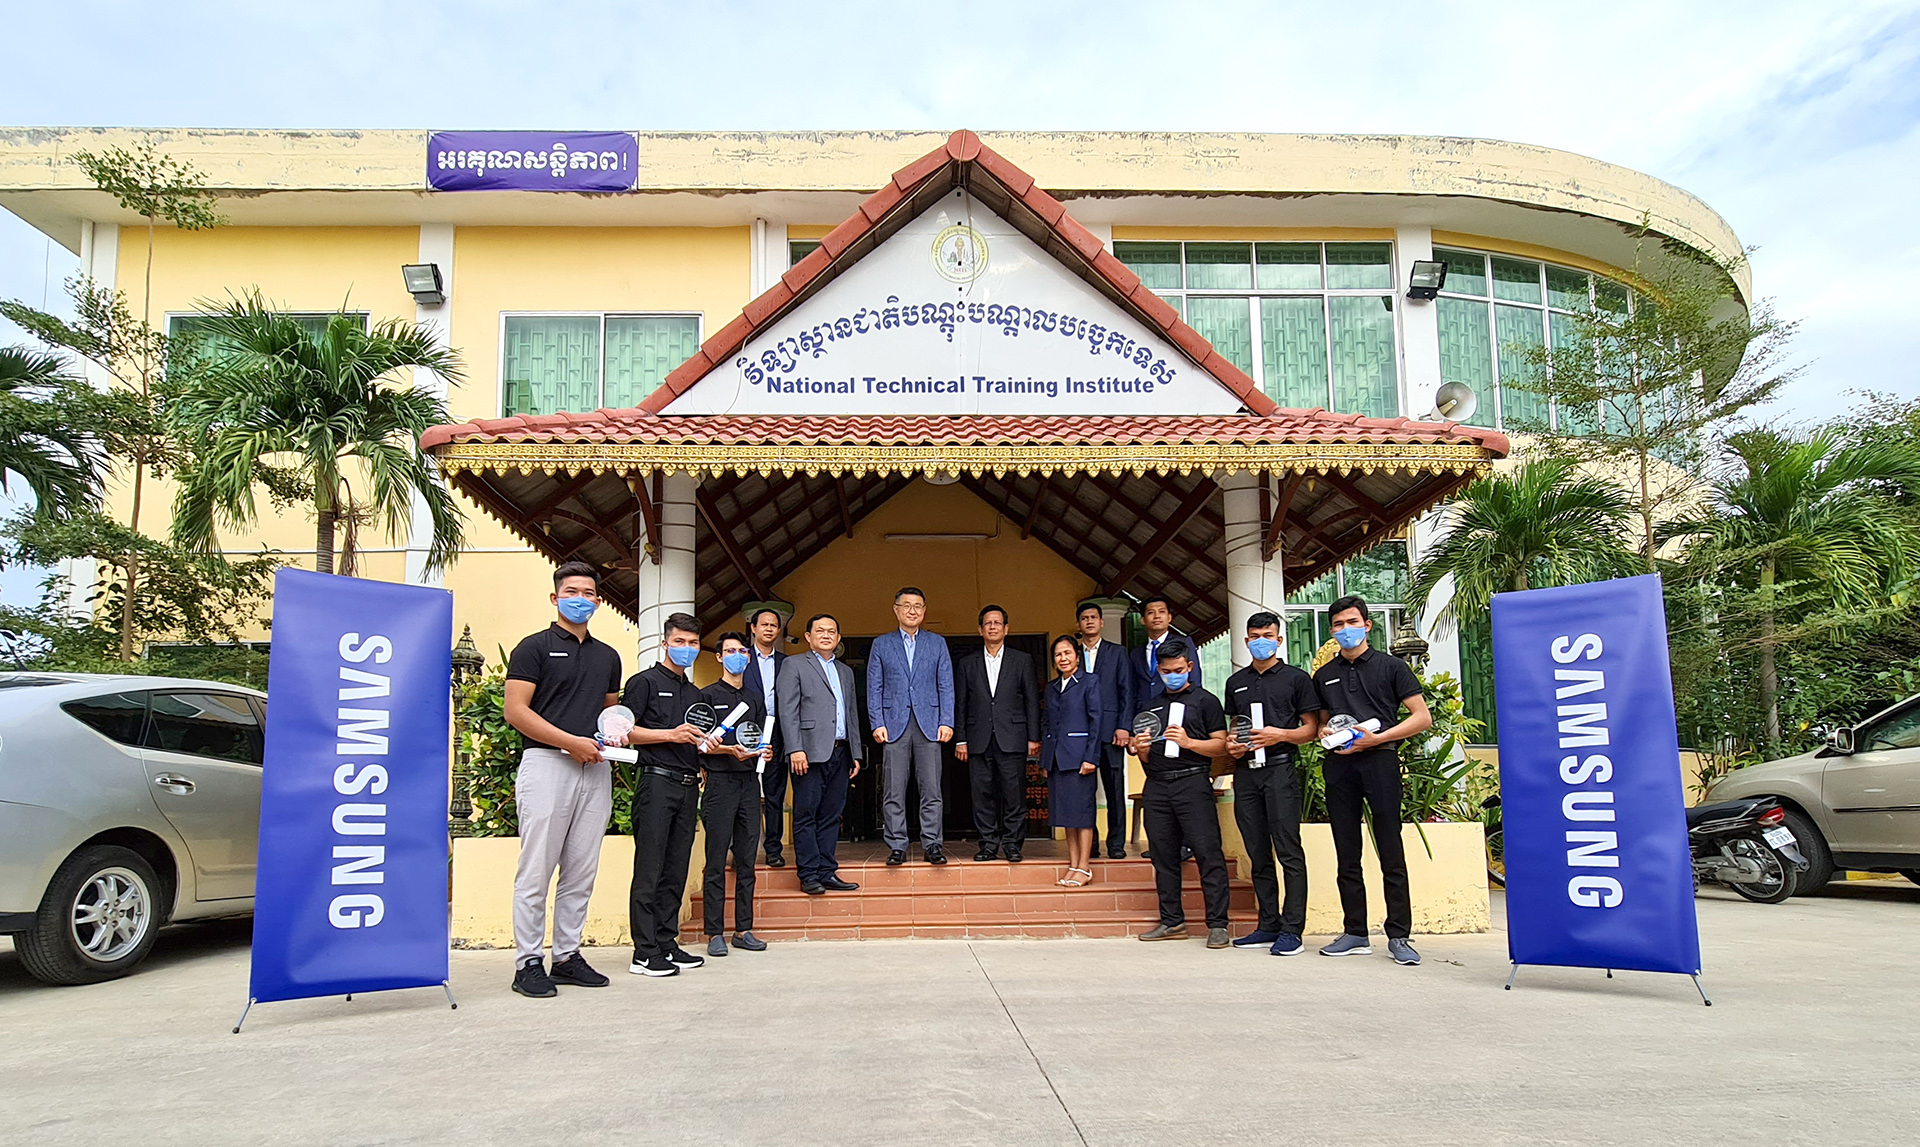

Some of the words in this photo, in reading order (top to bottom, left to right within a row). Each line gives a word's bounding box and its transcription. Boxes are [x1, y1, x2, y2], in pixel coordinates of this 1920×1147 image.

[766, 376, 856, 394] National
[862, 376, 966, 394] Technical
[971, 376, 1059, 398] Training
[1065, 376, 1155, 394] Institute
[328, 632, 393, 929] SAMSUNG
[1550, 633, 1624, 908] SAMSUNG
